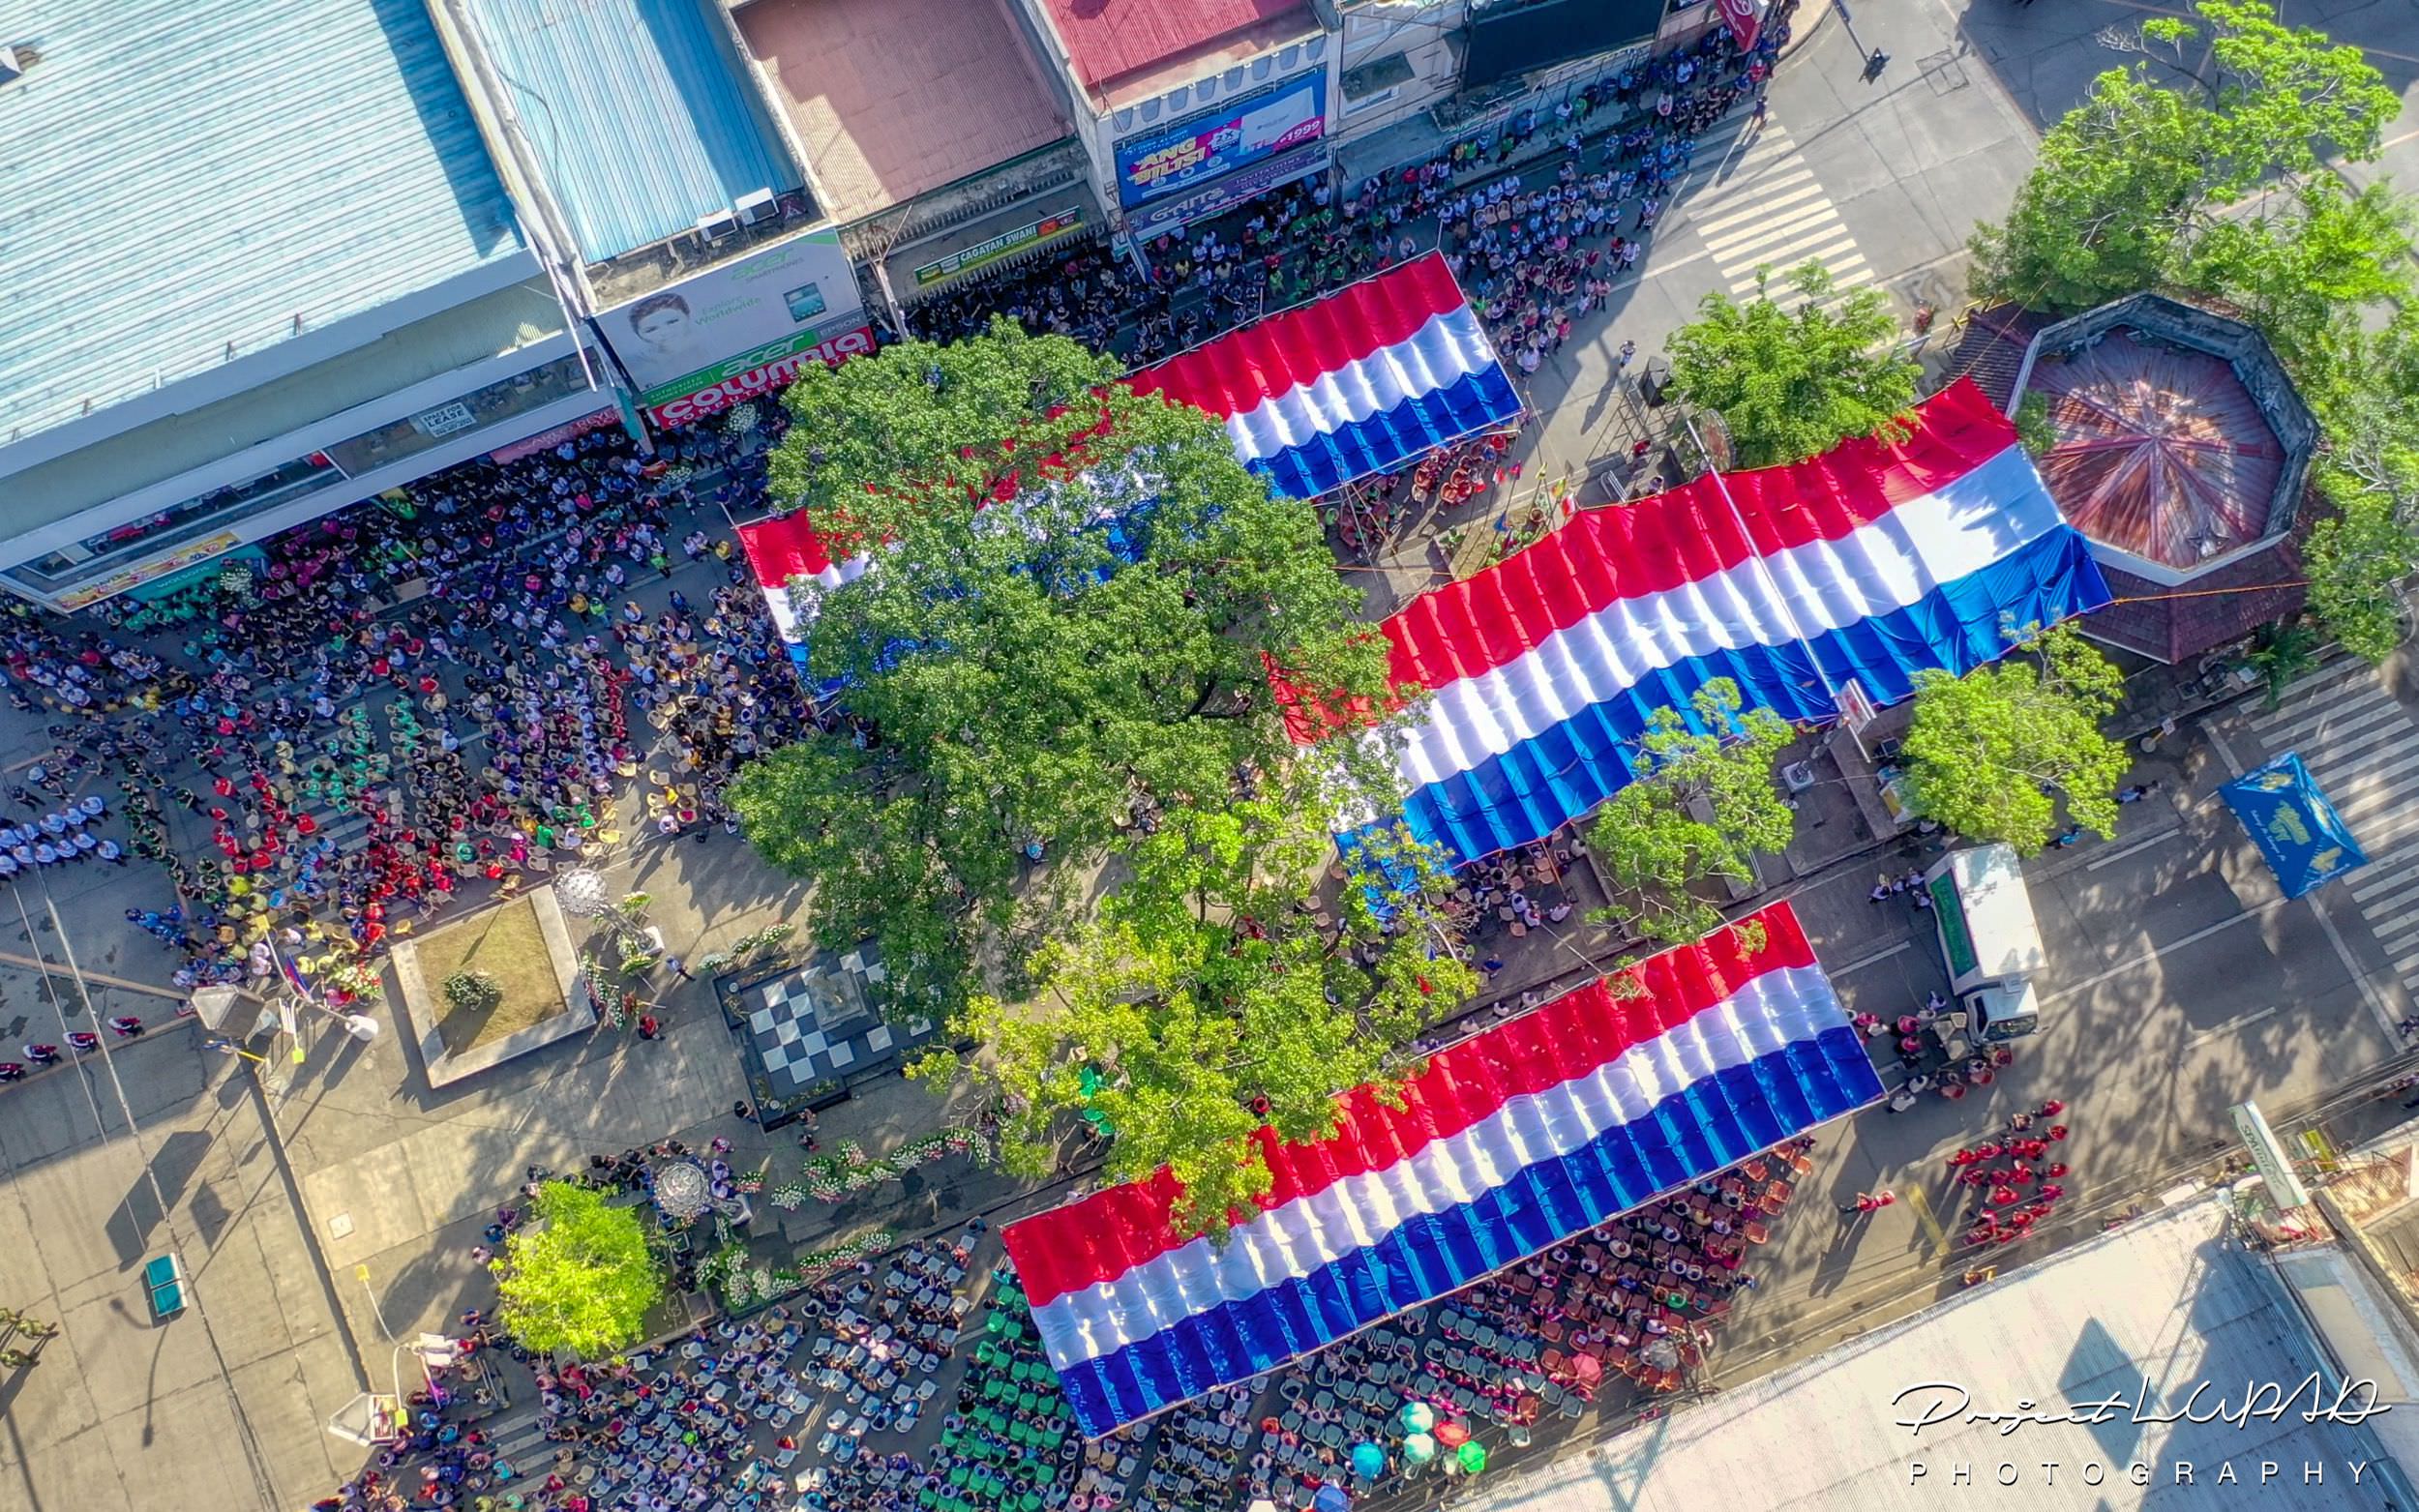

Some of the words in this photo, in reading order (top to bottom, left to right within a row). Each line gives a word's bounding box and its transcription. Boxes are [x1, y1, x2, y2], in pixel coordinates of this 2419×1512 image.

[1135, 136, 1197, 169] ANG
[731, 248, 795, 281] acer
[721, 335, 805, 378] acer
[428, 408, 464, 428] LEASE
